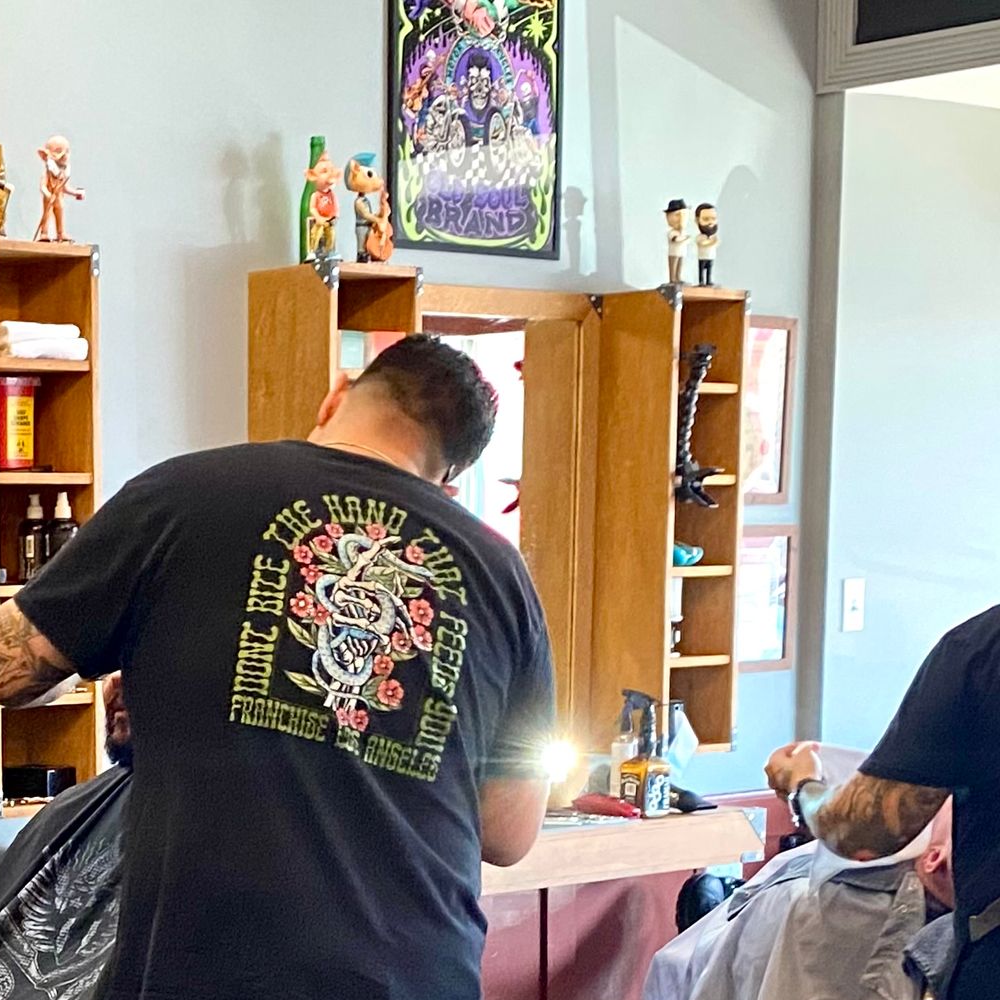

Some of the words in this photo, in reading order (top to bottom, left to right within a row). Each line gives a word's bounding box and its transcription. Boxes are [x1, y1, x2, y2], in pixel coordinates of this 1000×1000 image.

[423, 194, 527, 238] BRAND
[472, 184, 529, 210] SOUL
[263, 500, 322, 550] THE
[322, 494, 408, 535] HAND
[246, 554, 290, 617] BITE
[410, 527, 468, 606] THAT
[232, 620, 279, 696] DONT
[431, 610, 468, 698] FEEDS
[229, 694, 329, 742] FRANCHISE
[363, 735, 442, 782] ANGELES
[415, 697, 458, 753] YOU
